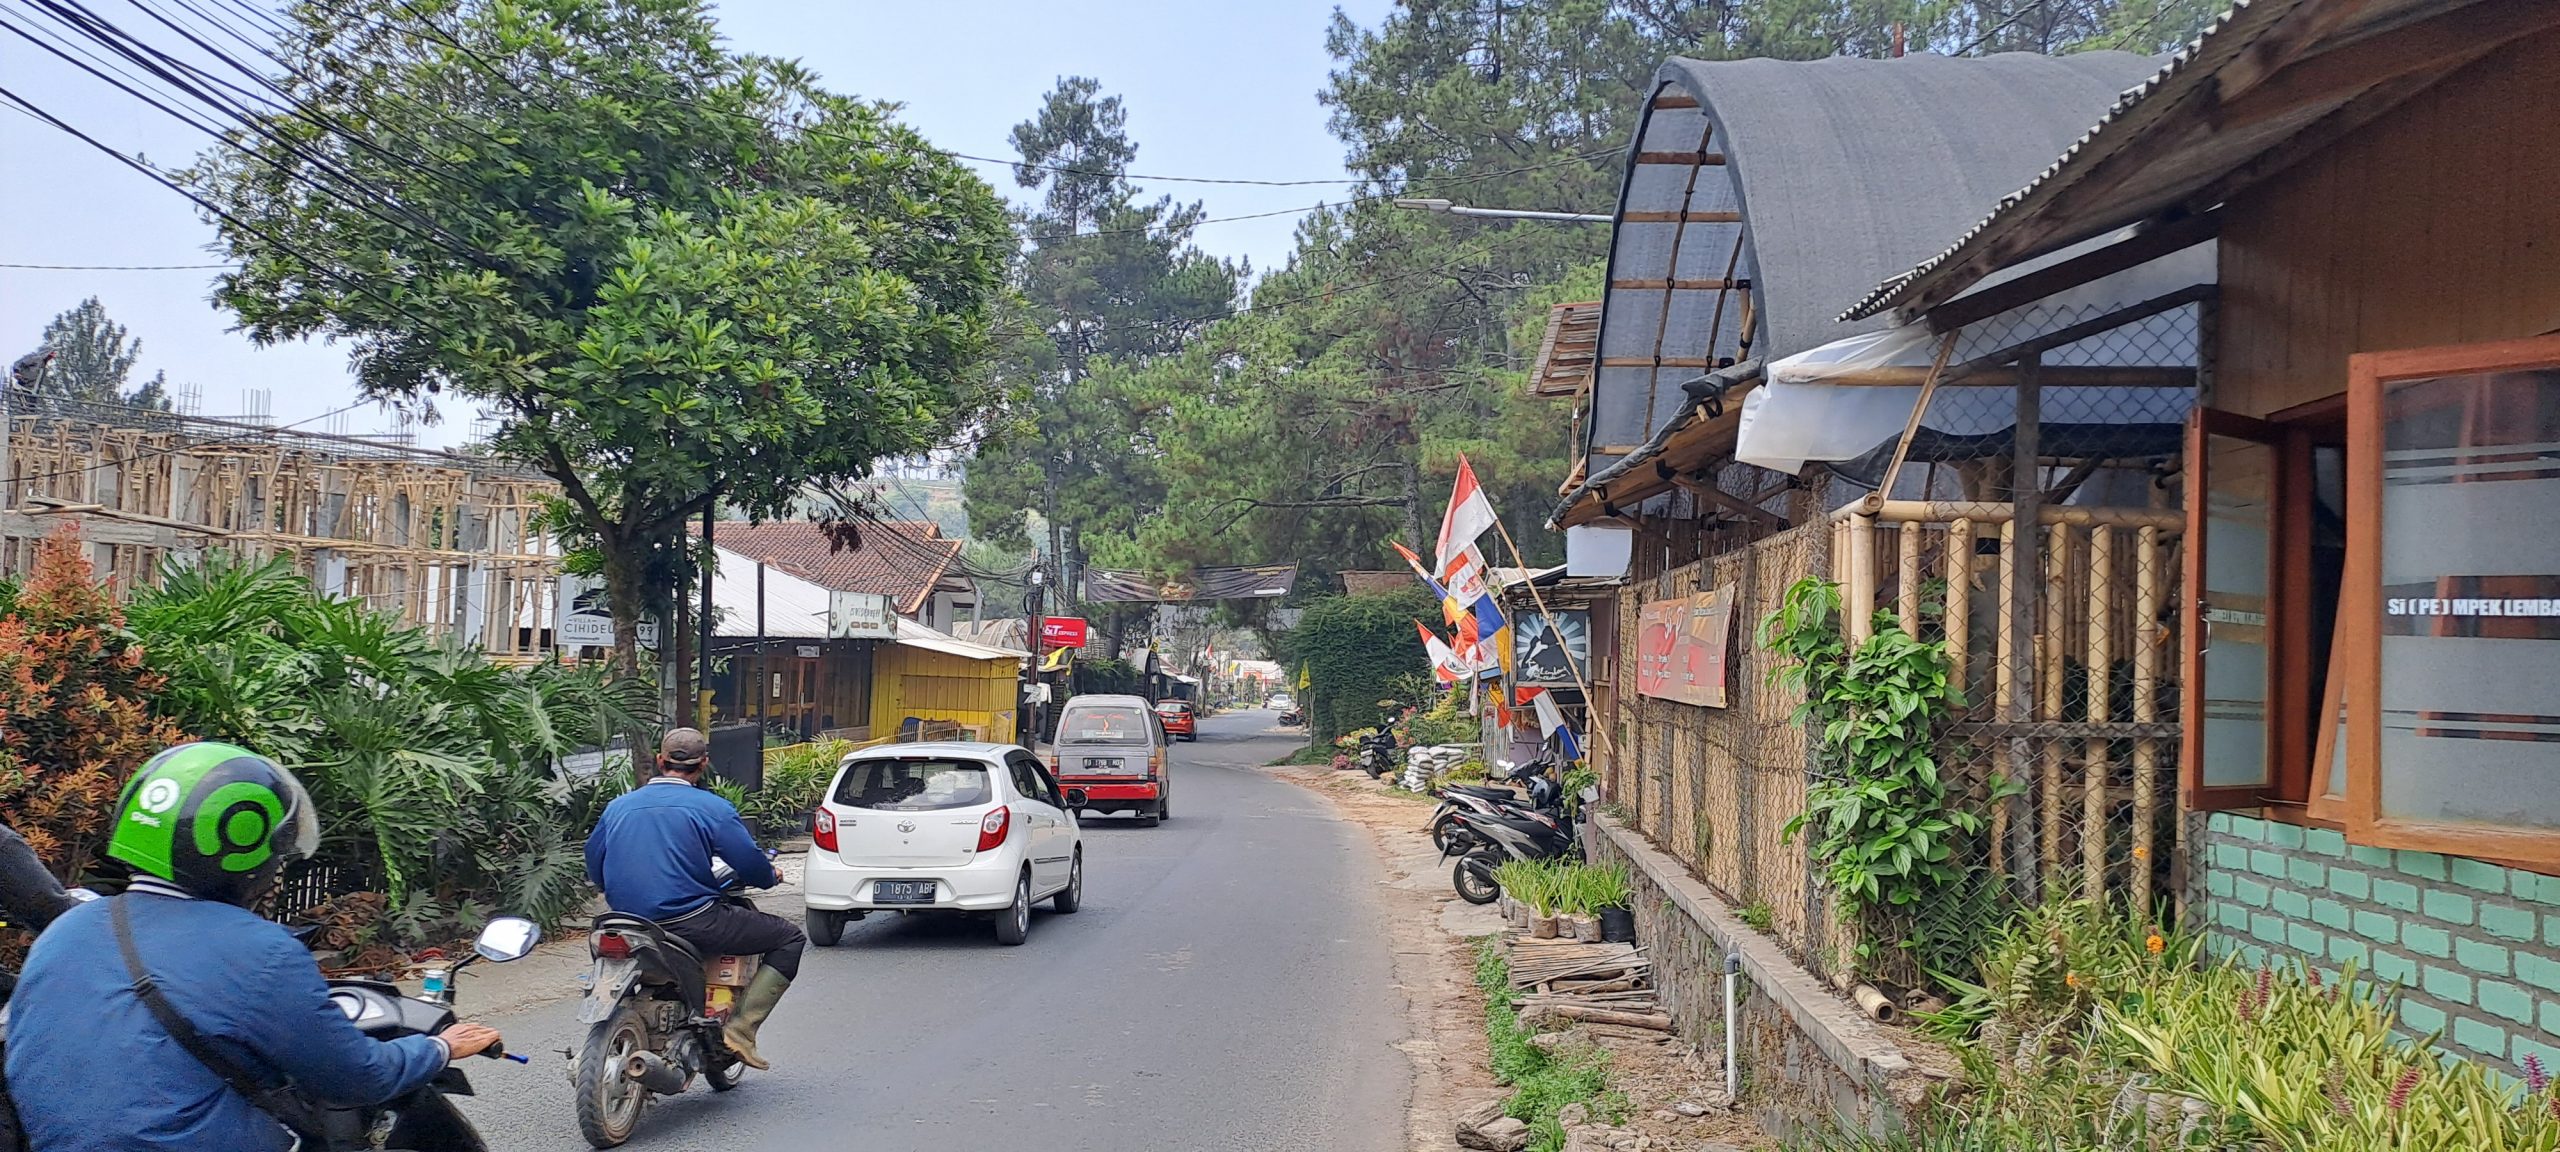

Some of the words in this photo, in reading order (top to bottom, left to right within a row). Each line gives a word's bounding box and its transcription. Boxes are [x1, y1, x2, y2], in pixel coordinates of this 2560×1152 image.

[2388, 598, 2406, 615] Si
[2452, 599, 2502, 616] MPEK
[564, 623, 614, 634] CIHIDEU
[639, 626, 653, 635] 99
[1044, 624, 1063, 636] &T
[874, 883, 880, 894] D
[890, 883, 912, 894] 1875
[919, 883, 935, 894] ABF
